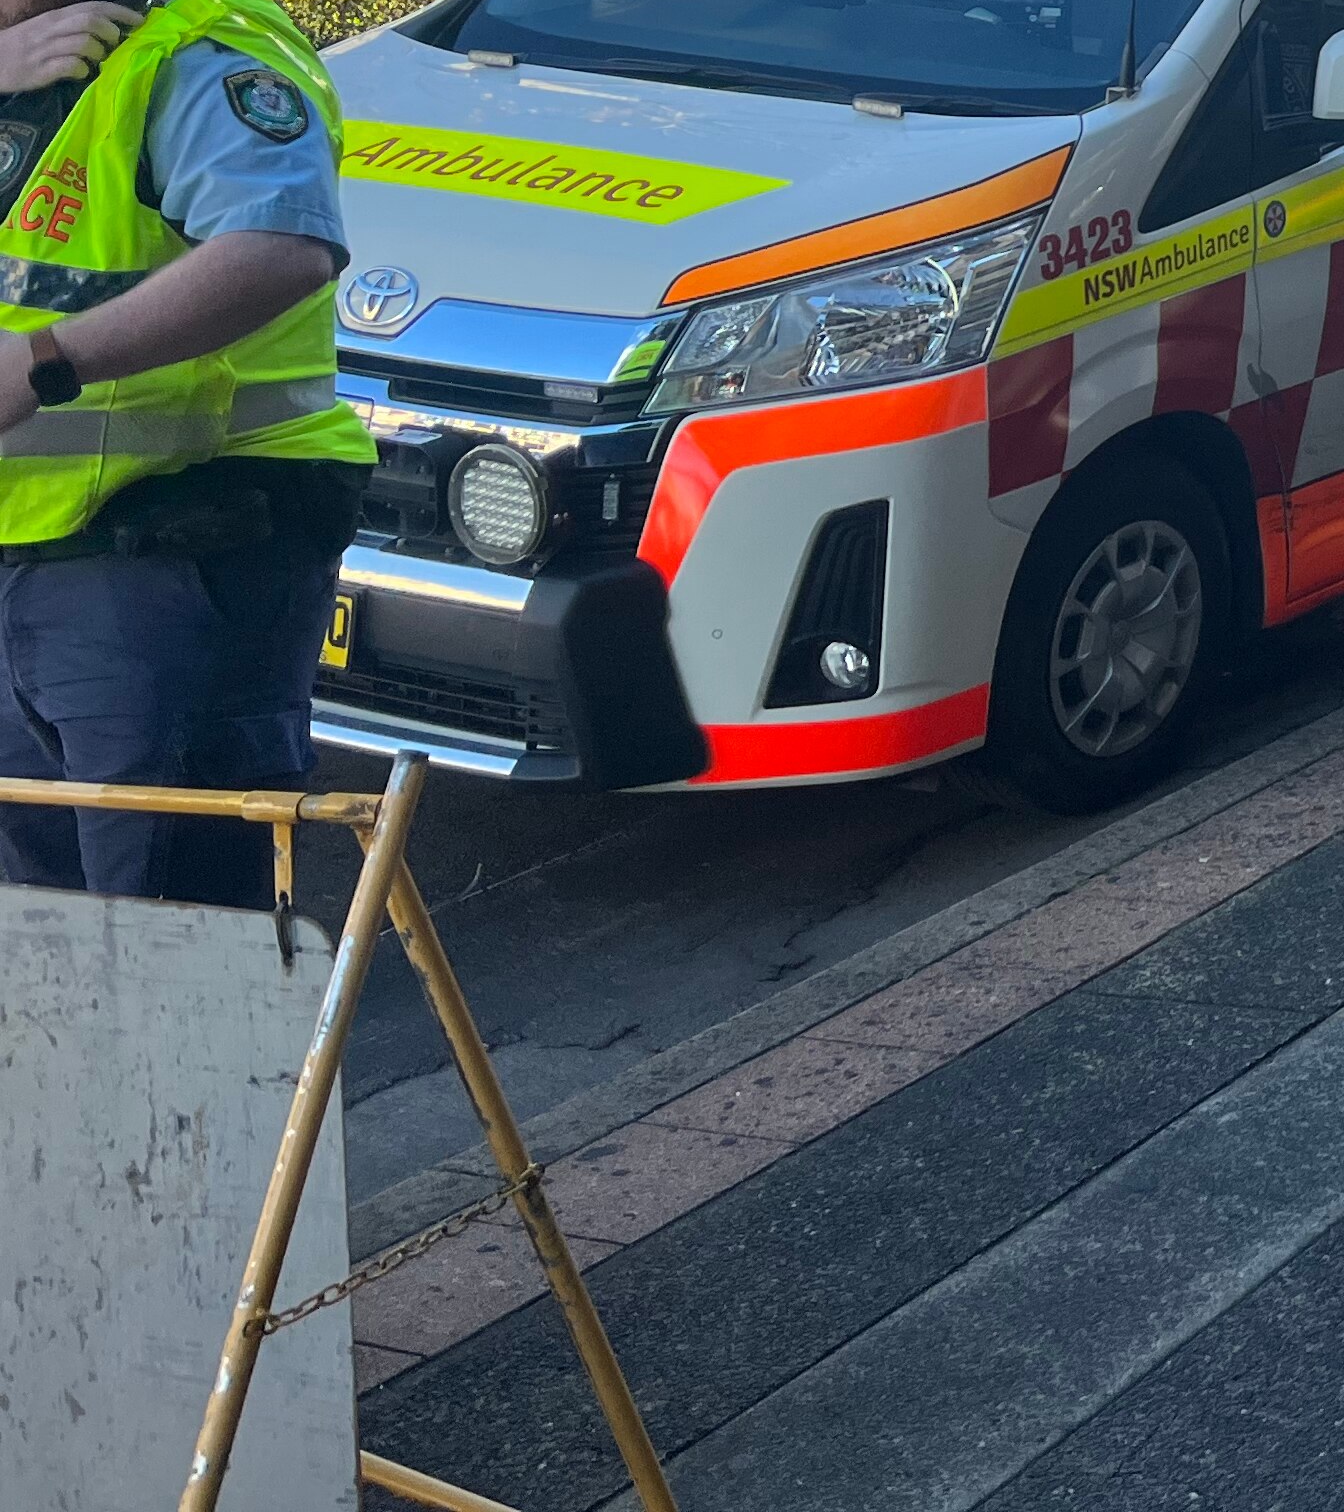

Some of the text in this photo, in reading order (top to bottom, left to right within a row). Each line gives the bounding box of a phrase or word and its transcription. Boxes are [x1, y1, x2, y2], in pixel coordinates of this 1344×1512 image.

[341, 135, 685, 210] Ambulance
[1038, 208, 1134, 281] 3423
[1083, 223, 1250, 306] NSW Ambulance
